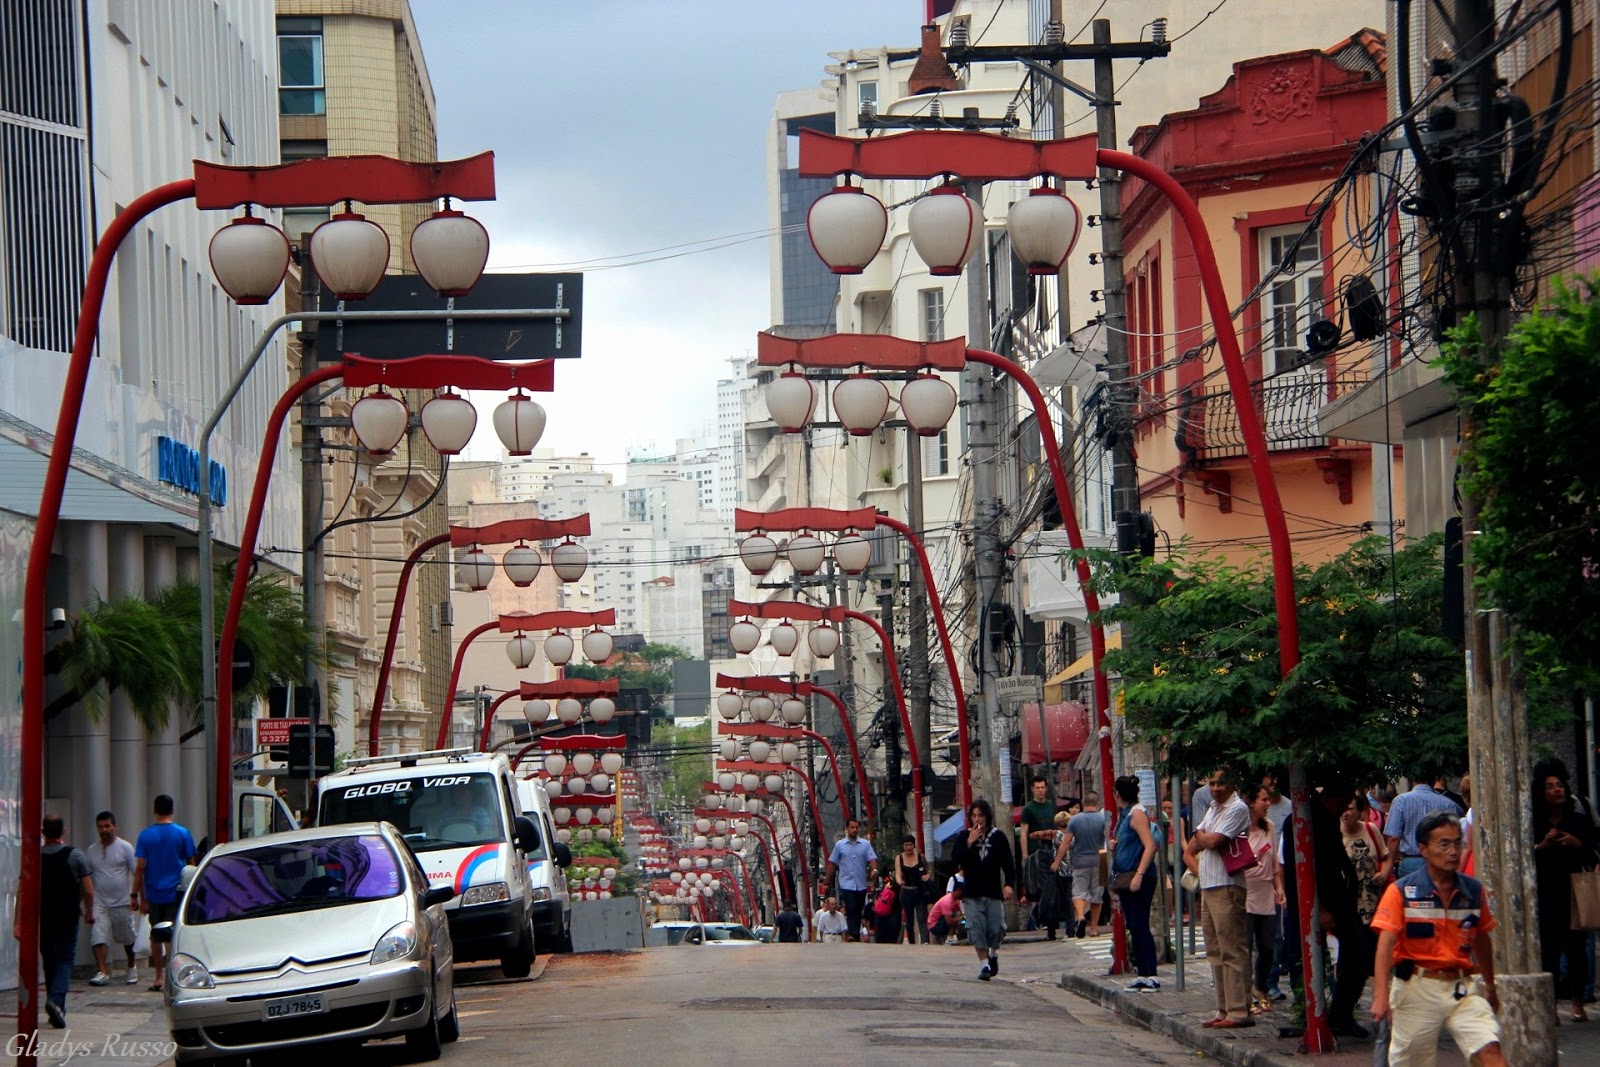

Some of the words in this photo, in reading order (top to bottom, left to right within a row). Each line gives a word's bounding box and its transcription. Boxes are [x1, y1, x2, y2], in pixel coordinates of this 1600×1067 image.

[997, 679, 1016, 690] Galvão
[1017, 677, 1036, 687] Bueno
[344, 781, 412, 800] GLOBO
[423, 776, 471, 788] VIDA
